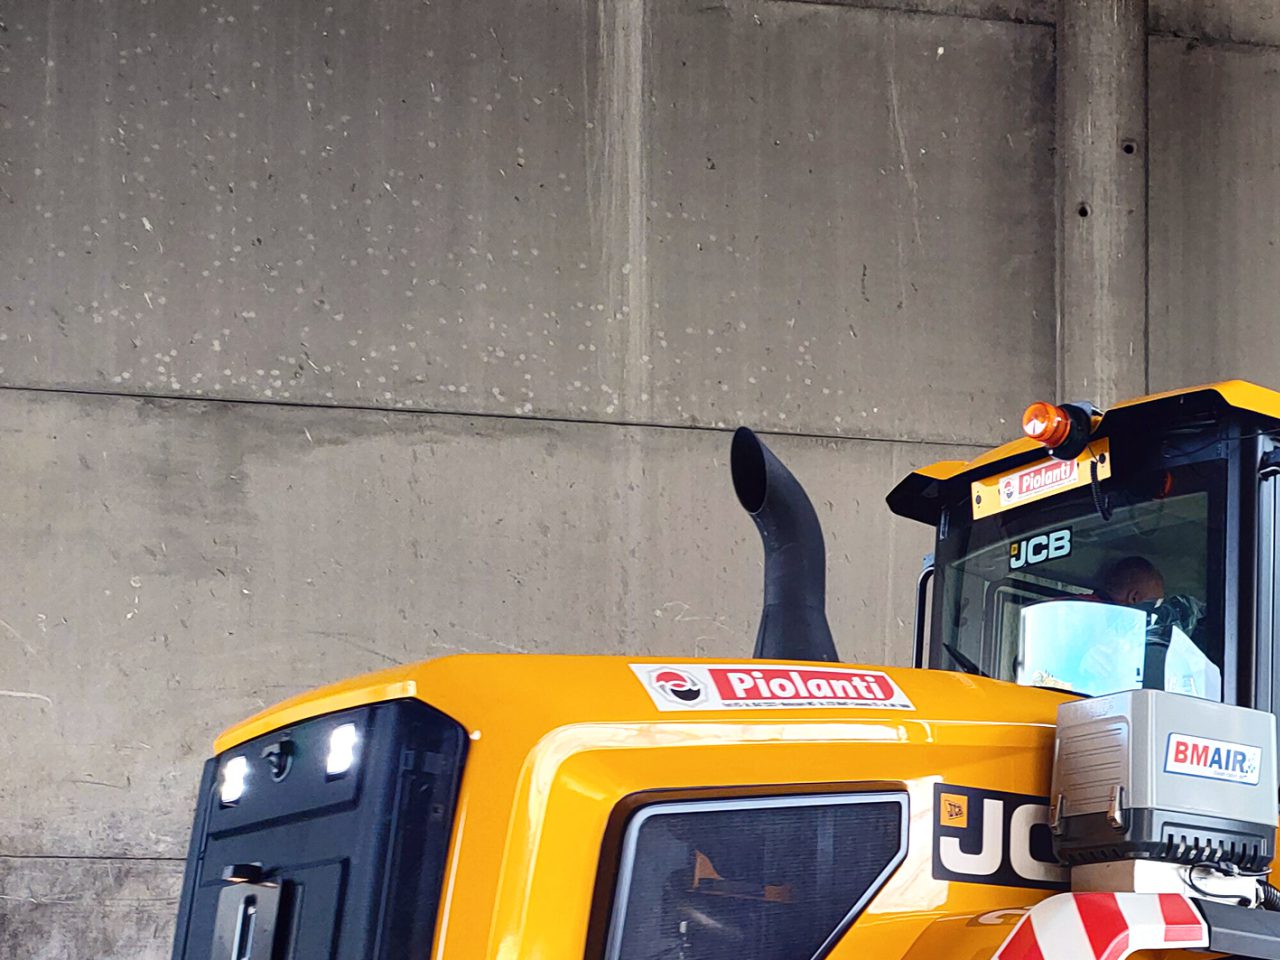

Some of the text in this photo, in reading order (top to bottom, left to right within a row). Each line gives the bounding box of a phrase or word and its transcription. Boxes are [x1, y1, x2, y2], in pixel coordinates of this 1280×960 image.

[1022, 461, 1071, 493] Piolanti
[1010, 529, 1072, 569] JCB
[728, 672, 886, 700] Piolanti
[1174, 740, 1249, 774] BMAIR
[939, 798, 1071, 882] JC
